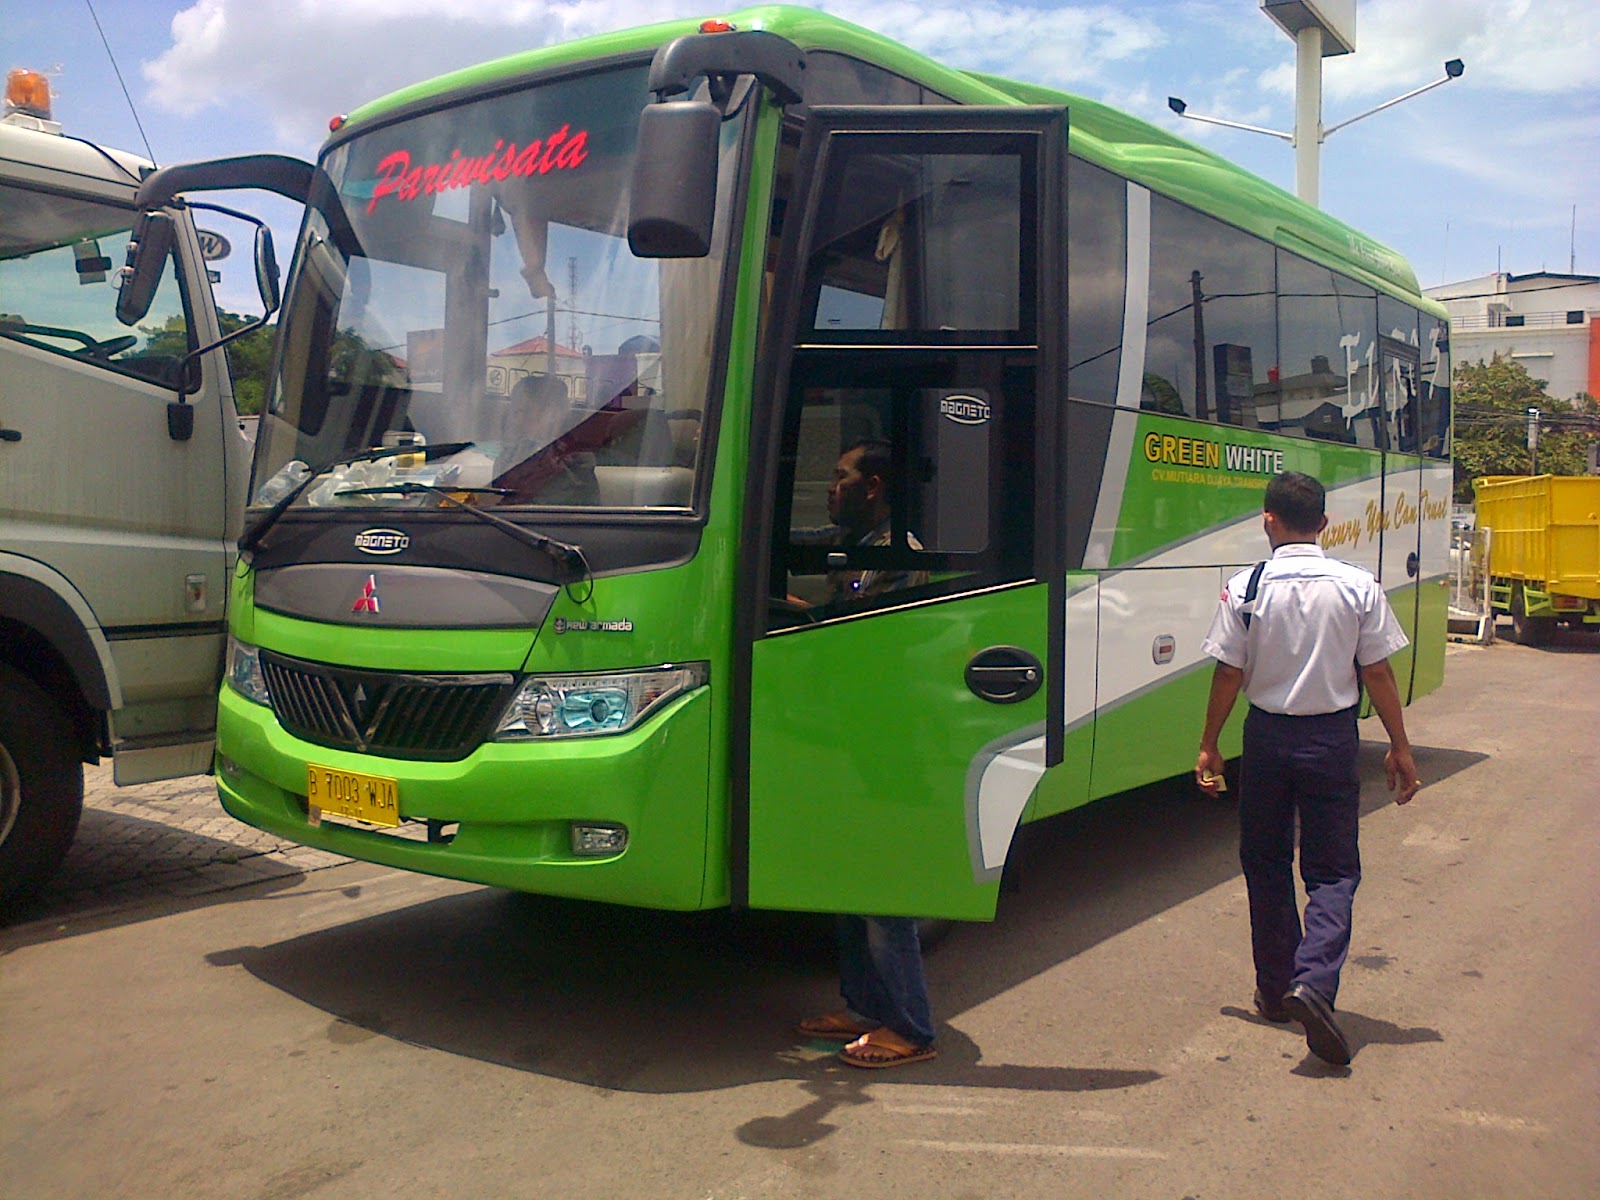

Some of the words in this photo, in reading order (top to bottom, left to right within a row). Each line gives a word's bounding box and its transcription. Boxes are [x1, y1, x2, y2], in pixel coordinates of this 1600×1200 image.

[367, 123, 589, 215] Pariwisata
[1144, 432, 1220, 469] GREEN
[1225, 444, 1284, 474] WHITE
[1365, 499, 1390, 542] You
[1394, 491, 1417, 529] Can
[1420, 489, 1448, 521] Trust
[309, 768, 319, 796] B
[325, 773, 361, 803] 7003
[367, 780, 396, 812] WJA
